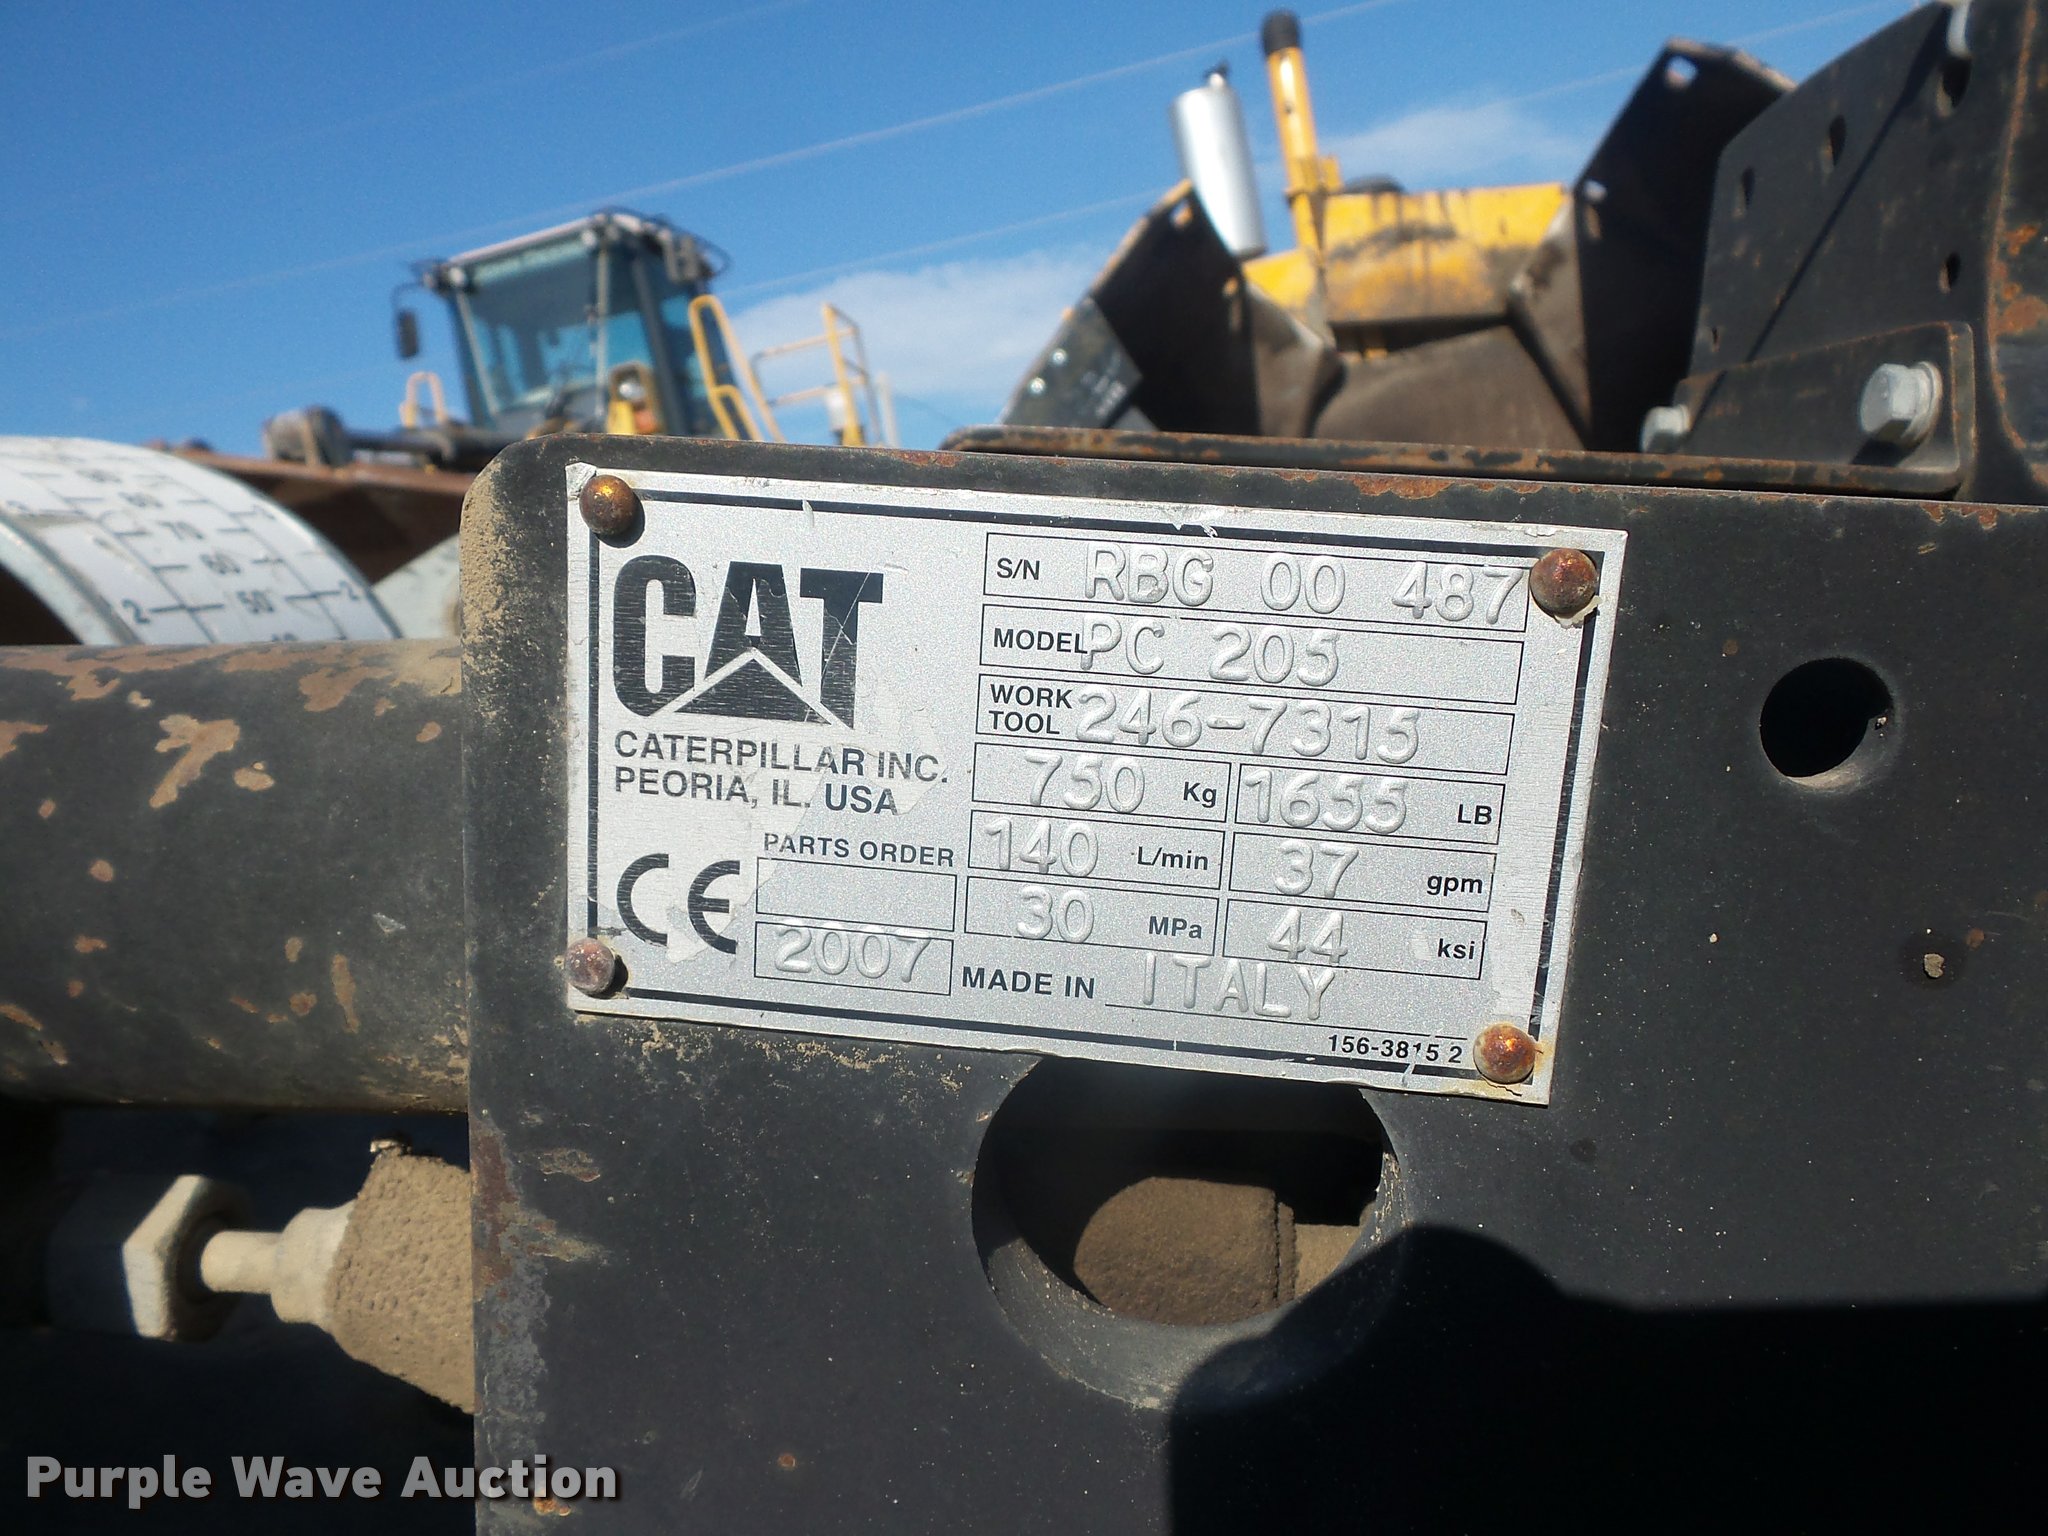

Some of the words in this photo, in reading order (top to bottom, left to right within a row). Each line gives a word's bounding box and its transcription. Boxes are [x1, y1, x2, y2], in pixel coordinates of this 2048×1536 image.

[122, 599, 150, 623] 2
[996, 558, 1041, 580] S/N
[1085, 541, 1214, 606] RBG
[1392, 561, 1524, 625] 487
[613, 555, 884, 729] CAT
[993, 628, 1088, 654] MODEL
[1080, 614, 1165, 674] PC
[1209, 624, 1339, 687] 205
[989, 711, 1060, 734] TOOL
[1076, 687, 1419, 764] 246-7315
[990, 684, 1073, 709] WORK
[614, 730, 866, 776] CATERPILLAR
[878, 751, 948, 783] INC.
[1025, 750, 1145, 814] 750
[1183, 781, 1217, 808] Kg
[615, 766, 758, 808] PEORIA,
[825, 783, 898, 815] USA
[1245, 769, 1407, 834] 1655
[1457, 803, 1493, 825] LB
[764, 833, 850, 857] PARTS
[859, 841, 954, 867] ORDER
[984, 818, 1098, 877] 140
[1137, 846, 1209, 870] L/min
[1273, 839, 1359, 899] 37
[1427, 875, 1483, 897] gpm
[616, 853, 740, 954] CE
[1016, 885, 1094, 944] 30
[1148, 916, 1203, 939] MPa
[775, 920, 931, 982] 2007
[1267, 906, 1348, 966] 44
[1437, 938, 1475, 960] ksi
[962, 966, 1052, 995] MADE
[1065, 976, 1095, 999] IN
[1143, 951, 1335, 1020] ITALY
[1328, 1034, 1439, 1062] 156-3815
[1448, 1045, 1463, 1063] 2
